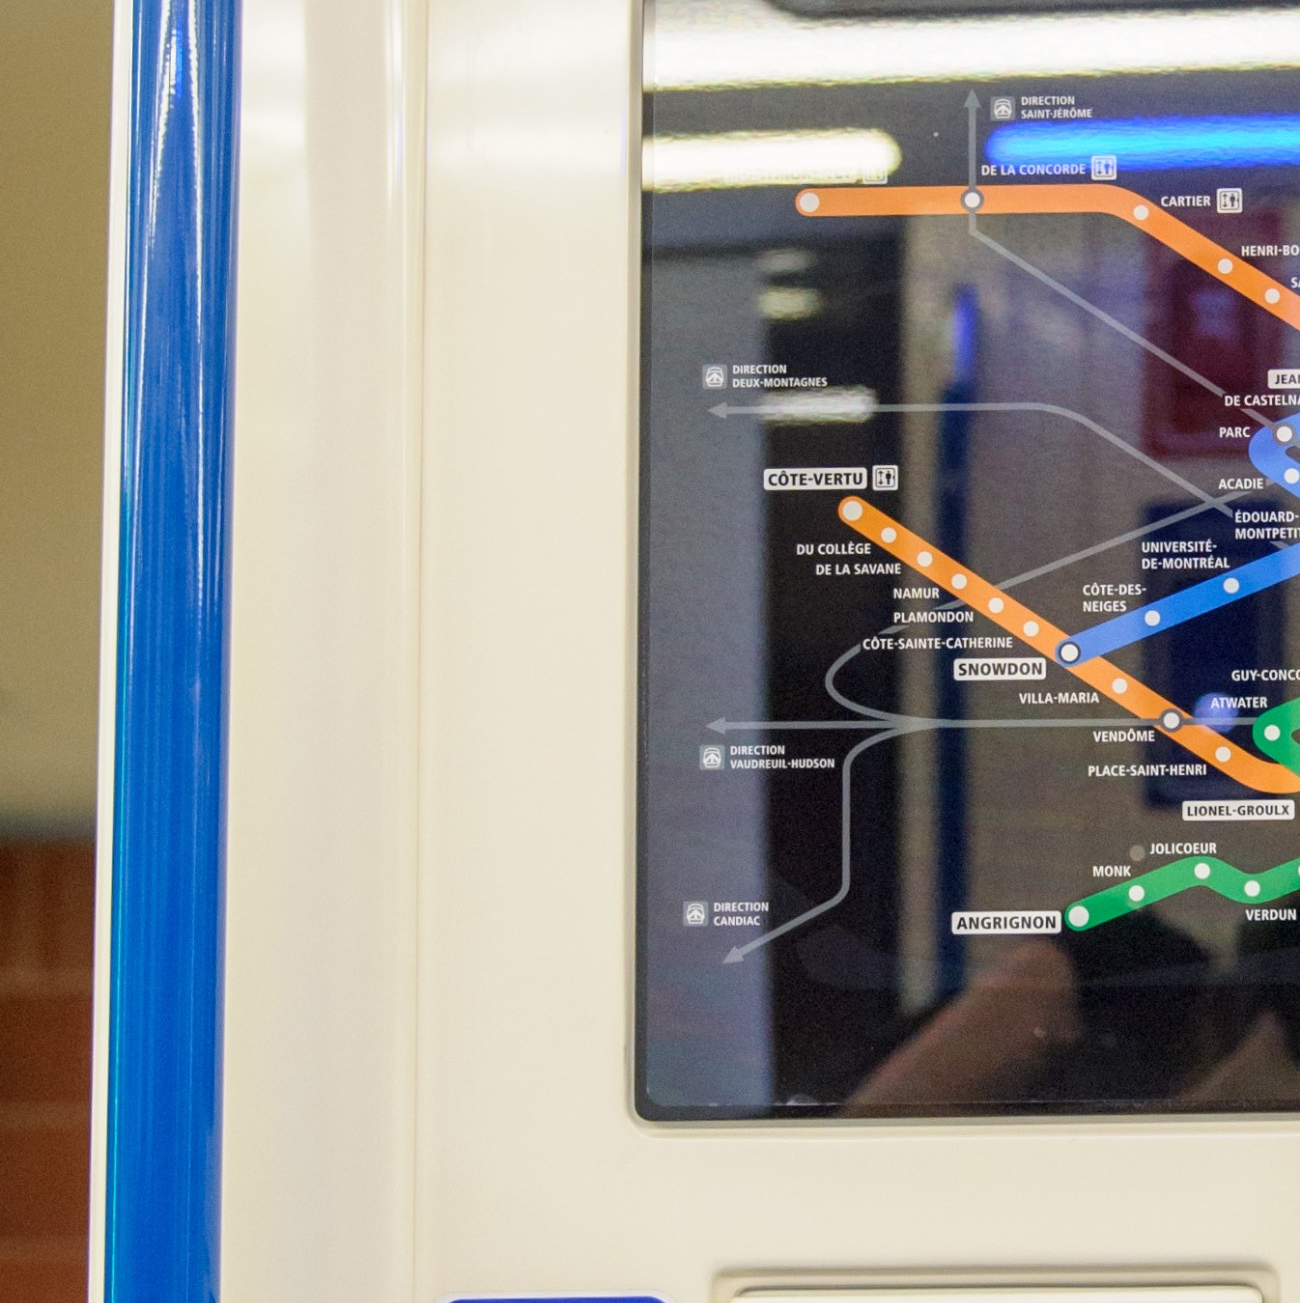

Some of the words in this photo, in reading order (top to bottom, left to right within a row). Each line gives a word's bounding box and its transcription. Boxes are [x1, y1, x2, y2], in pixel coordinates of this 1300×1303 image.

[1021, 96, 1075, 105] DIRECTION
[1021, 107, 1093, 120] SAINT-JÉRÔME
[982, 164, 997, 176] DE
[1001, 164, 1014, 175] LA
[1018, 163, 1086, 175] CONCORDE
[1161, 195, 1210, 207] CARTIER
[733, 365, 787, 374] DIRECTION
[732, 376, 828, 388] DEUX-MONTAGNES
[1225, 396, 1239, 407] DE
[1219, 427, 1250, 438] PARC
[769, 469, 863, 487] CÔTE-VERTU
[1219, 478, 1263, 490] ACADIE
[1235, 510, 1299, 524] ÉDOUARD-
[797, 545, 812, 554] DU
[1142, 541, 1217, 553] UNIVERSITÉ-
[1142, 557, 1229, 569] DE-MONTRÉAL
[816, 565, 830, 575] DE
[835, 565, 850, 575] LA
[853, 564, 901, 575] SAVANE
[894, 588, 939, 598] NAMUR
[1083, 583, 1146, 596] CÔTE-DES-
[1083, 601, 1127, 612] NEIGES
[894, 612, 974, 623] PLAMONDON
[863, 636, 1013, 650] CÔTE-SAINTE-CATHERINE
[958, 661, 1043, 676] SNOWDON
[1019, 693, 1099, 704] VILLA-MARIA
[1211, 697, 1267, 709] ATWATER
[1093, 729, 1155, 742] VENDÔME
[730, 746, 785, 756] DIRECTION
[730, 758, 835, 769] VAUDREUIL-HUDSON
[1088, 765, 1207, 777] PLACE-SAINT-HENRI
[1187, 804, 1290, 818] LIONEL-GROULX
[1150, 843, 1217, 855] JOLICOEUR
[1093, 866, 1131, 876] MONK
[714, 902, 769, 912] DIRECTION
[714, 916, 760, 926] CANDIAC
[1246, 909, 1297, 921] VERDUN
[957, 915, 1057, 930] ANGRIGNON
